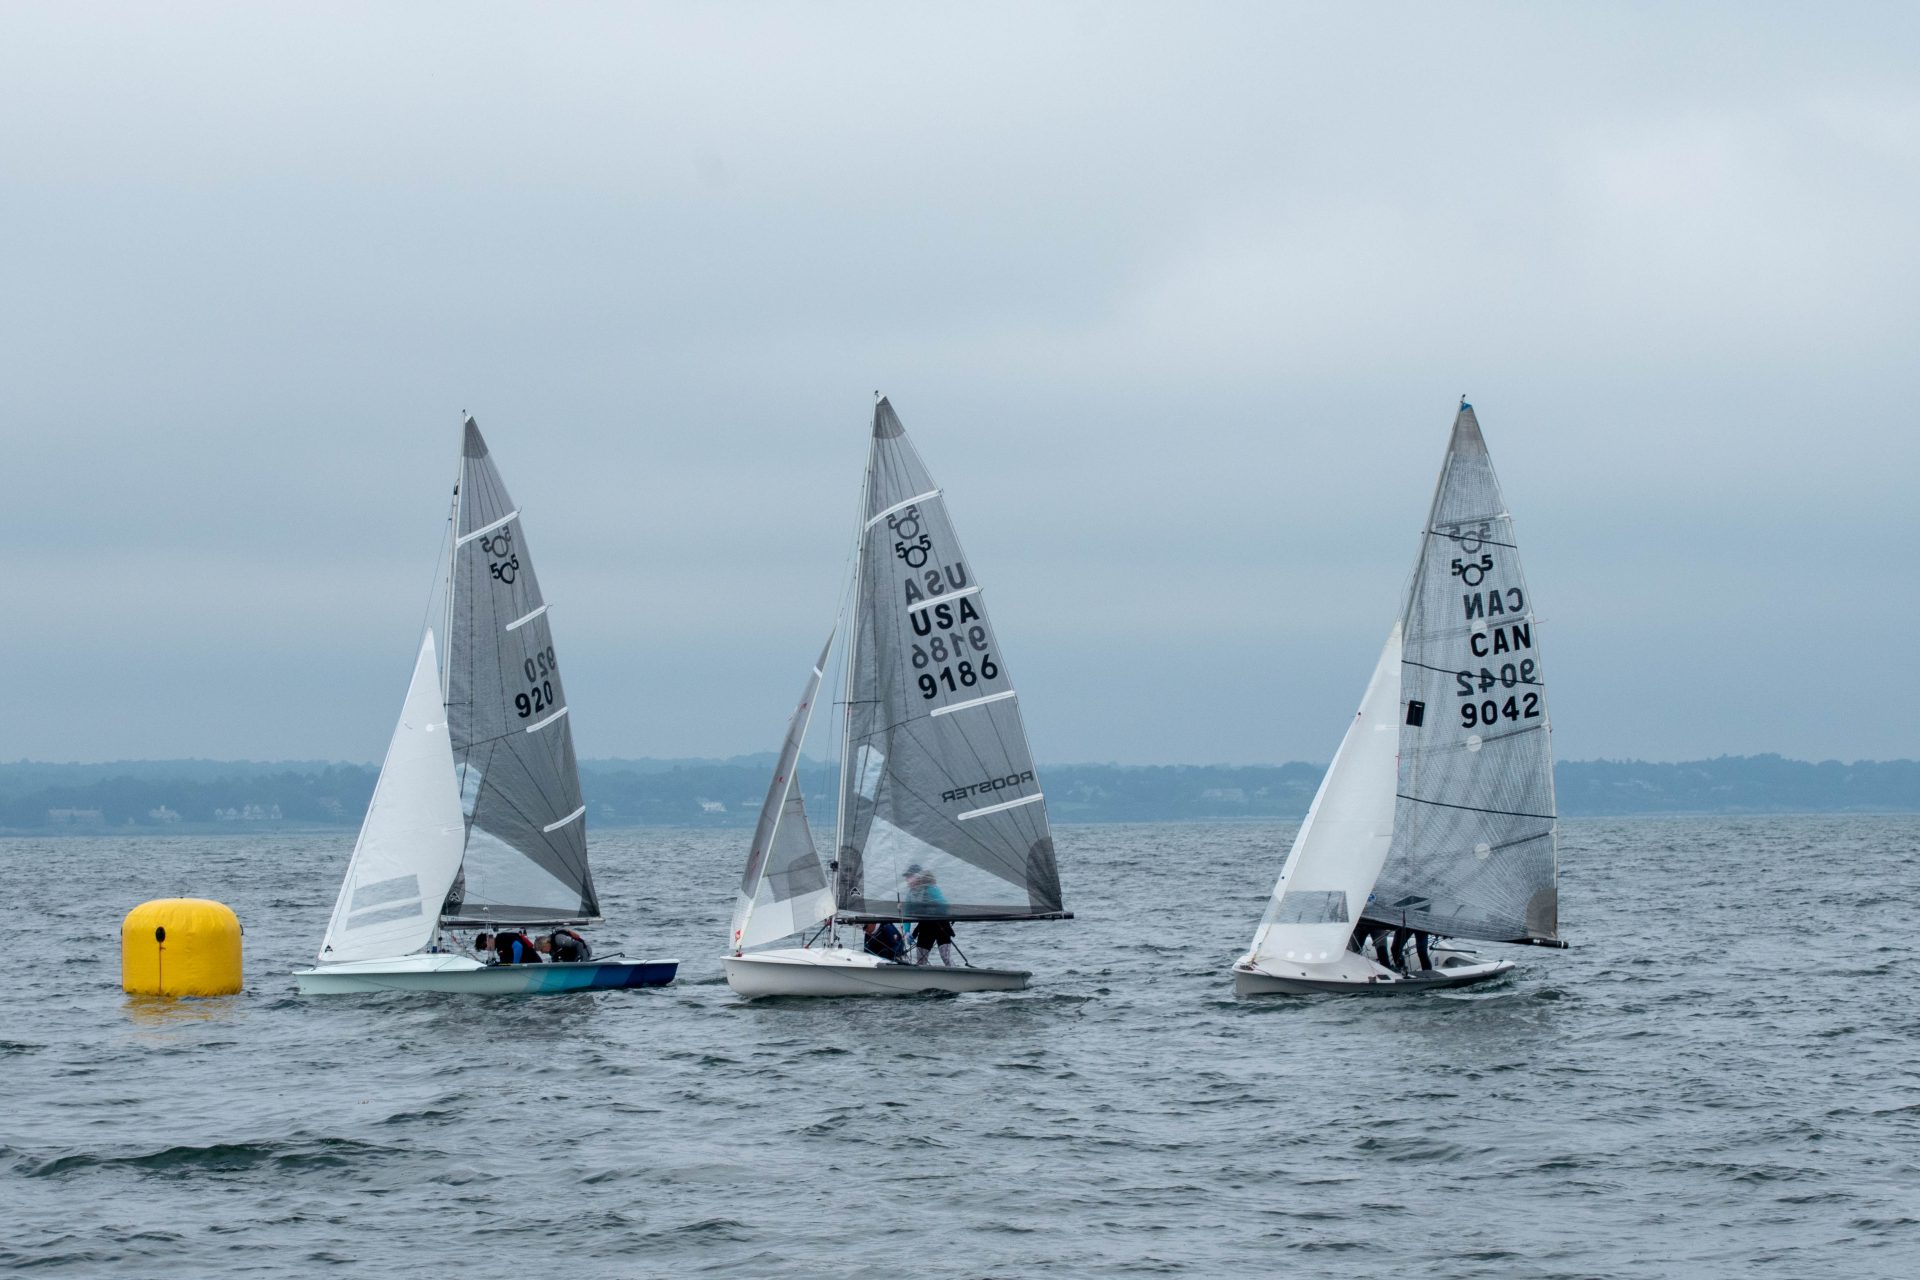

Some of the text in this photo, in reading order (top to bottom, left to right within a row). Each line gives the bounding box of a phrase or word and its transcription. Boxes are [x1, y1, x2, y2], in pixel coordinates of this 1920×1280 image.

[910, 597, 979, 636] USA
[1470, 623, 1531, 657] CAN
[918, 653, 998, 699] 9186
[515, 681, 553, 718] 920
[1461, 692, 1540, 728] 9042
